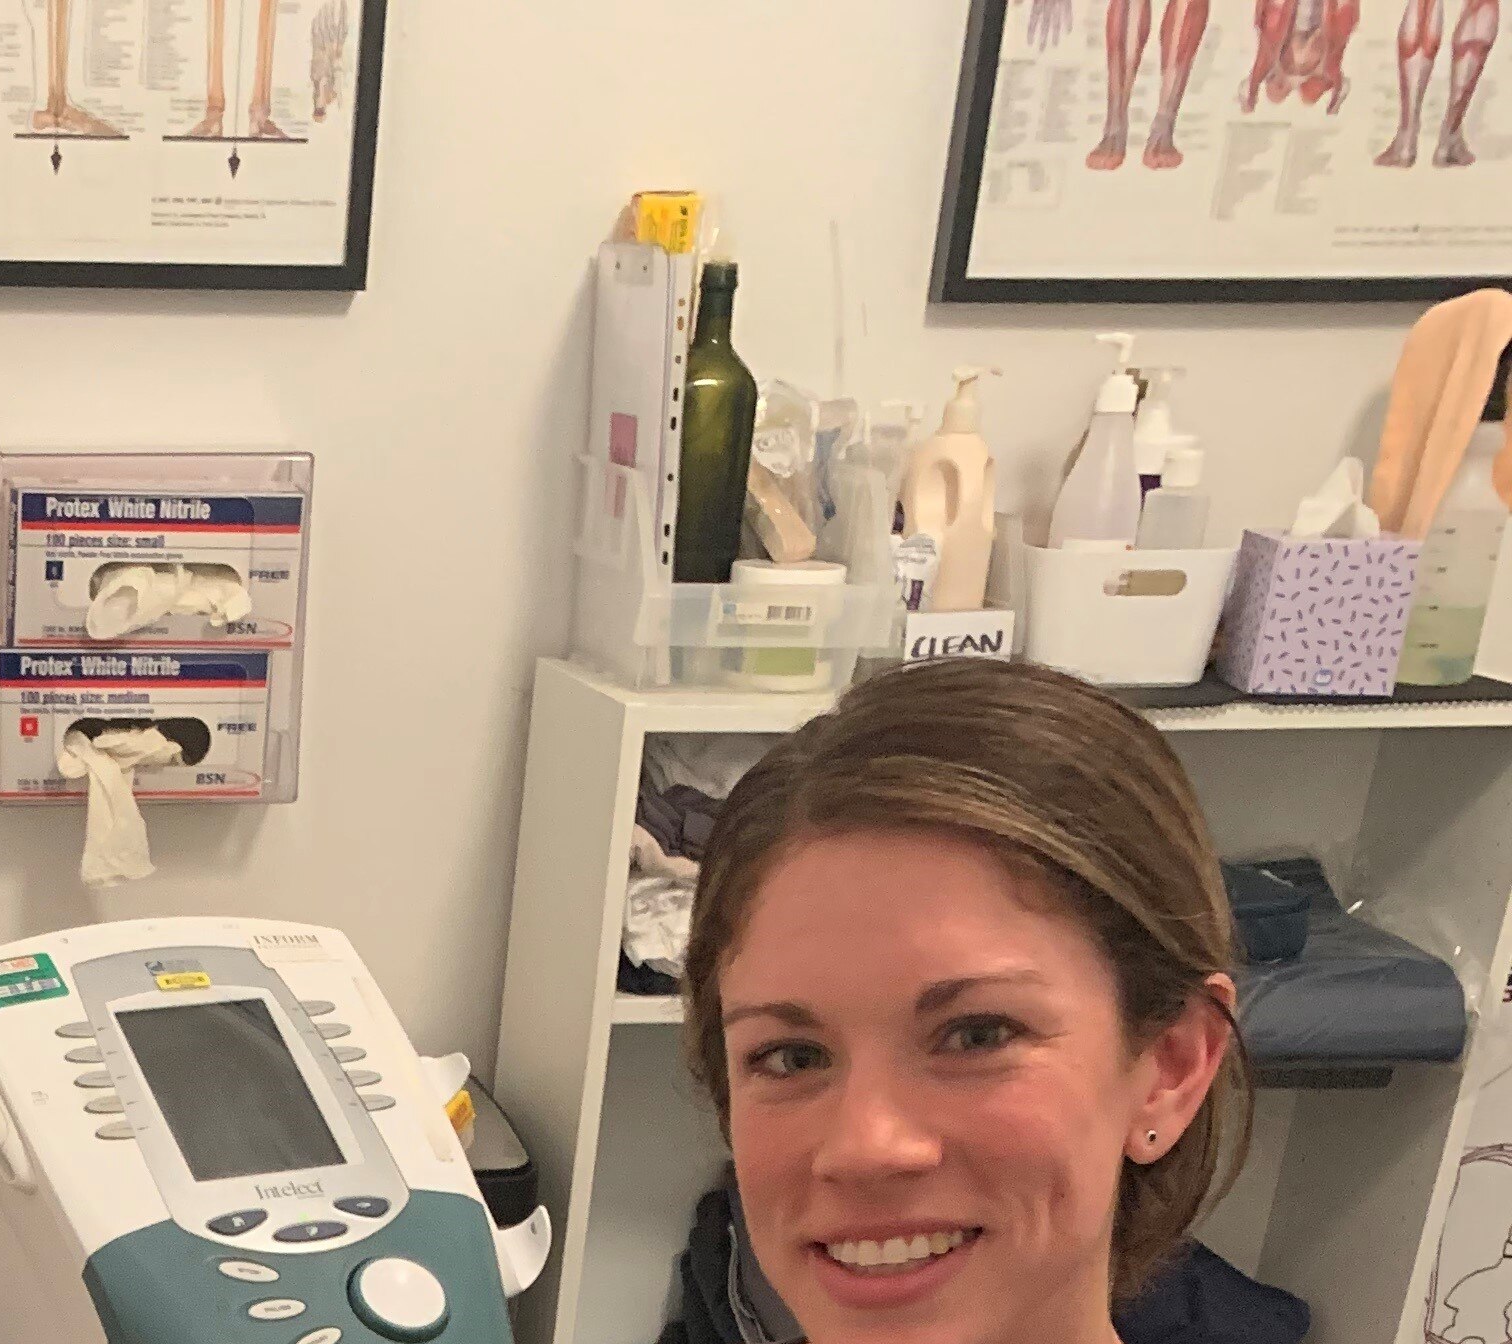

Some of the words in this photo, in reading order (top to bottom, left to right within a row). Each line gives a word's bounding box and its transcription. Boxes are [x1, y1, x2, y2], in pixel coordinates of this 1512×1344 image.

[45, 496, 101, 518] Protex
[108, 497, 156, 518] White
[160, 498, 212, 520] Nitrile
[226, 621, 257, 635] BSN
[910, 629, 1003, 658] CLEAN
[20, 655, 73, 676] Protex
[80, 655, 127, 676] White
[131, 656, 181, 676] Nitrile
[217, 722, 257, 731] FREE
[196, 773, 226, 785] BSN
[254, 1180, 324, 1200] Intelect
